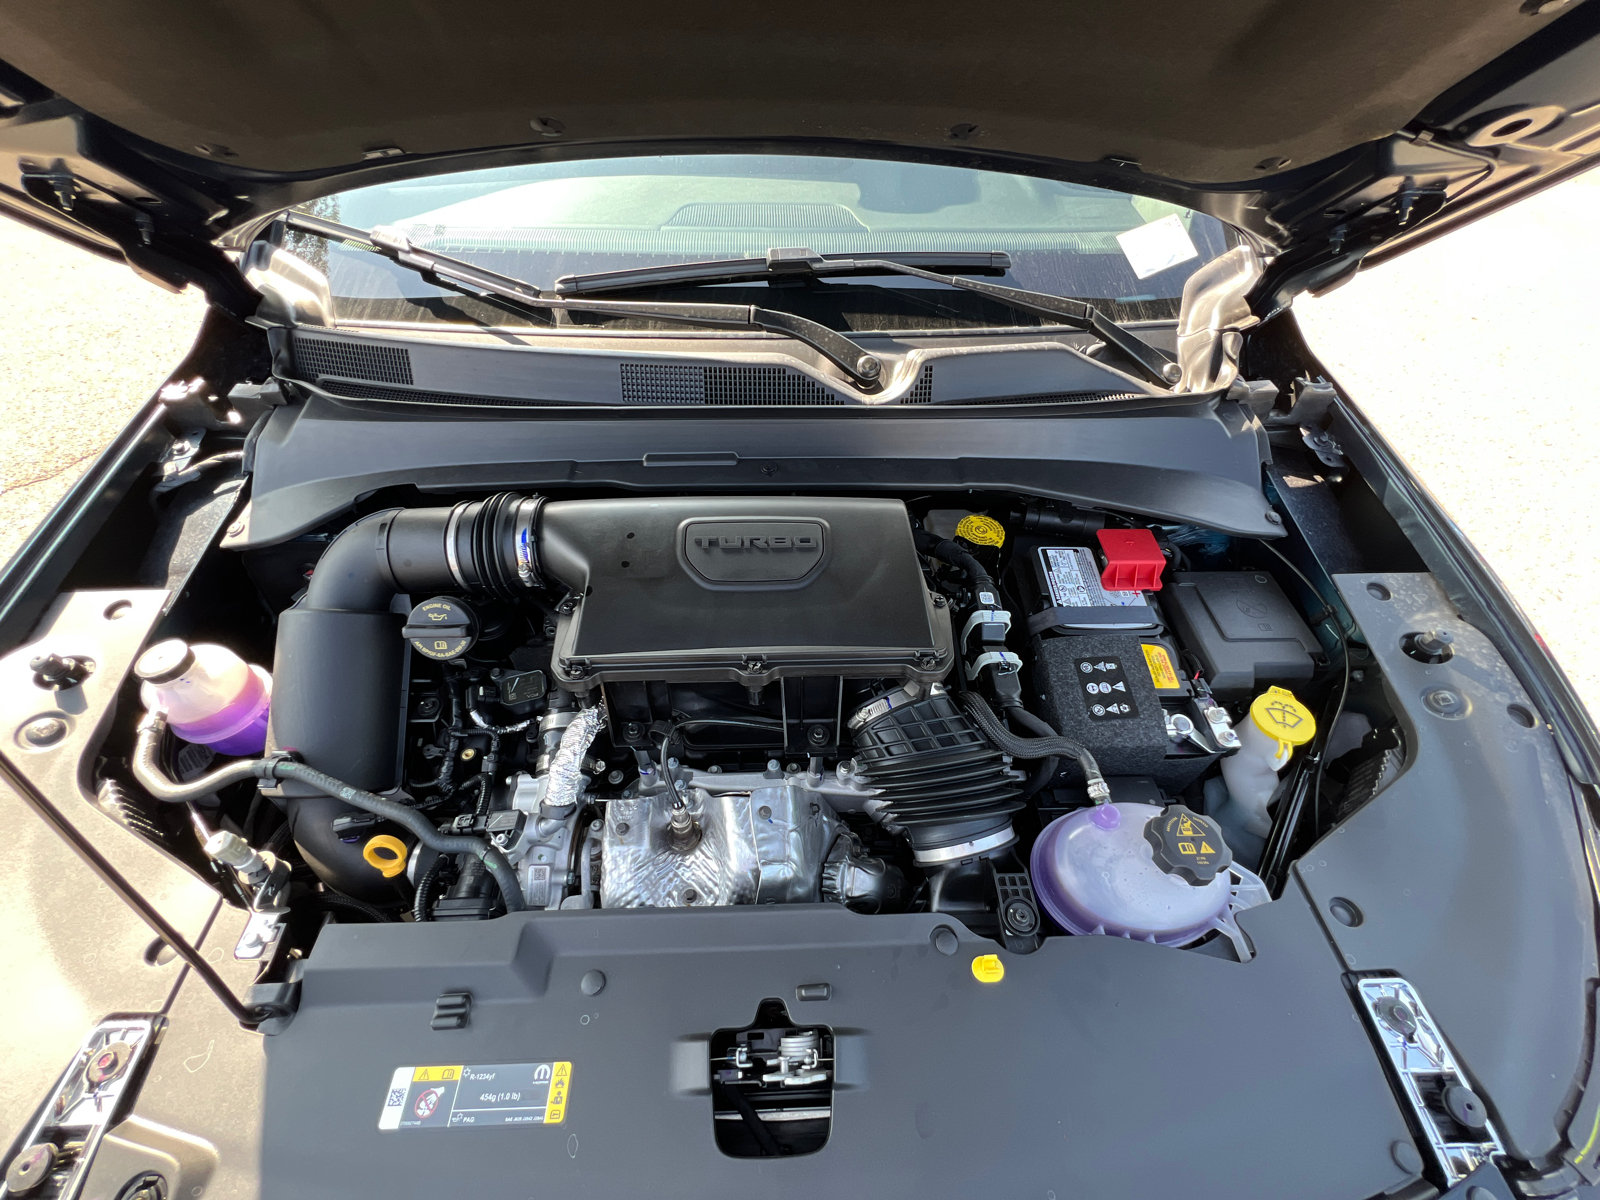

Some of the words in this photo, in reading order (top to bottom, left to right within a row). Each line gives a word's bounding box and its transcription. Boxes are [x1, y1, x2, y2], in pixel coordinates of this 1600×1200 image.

[693, 535, 818, 550] TURBO
[422, 603, 442, 611] ENGINE
[414, 641, 423, 649] API
[469, 1073, 496, 1081] R-1234yf
[480, 1093, 497, 1103] 454g
[497, 1092, 511, 1102] (1.0
[511, 1092, 521, 1101] lb)
